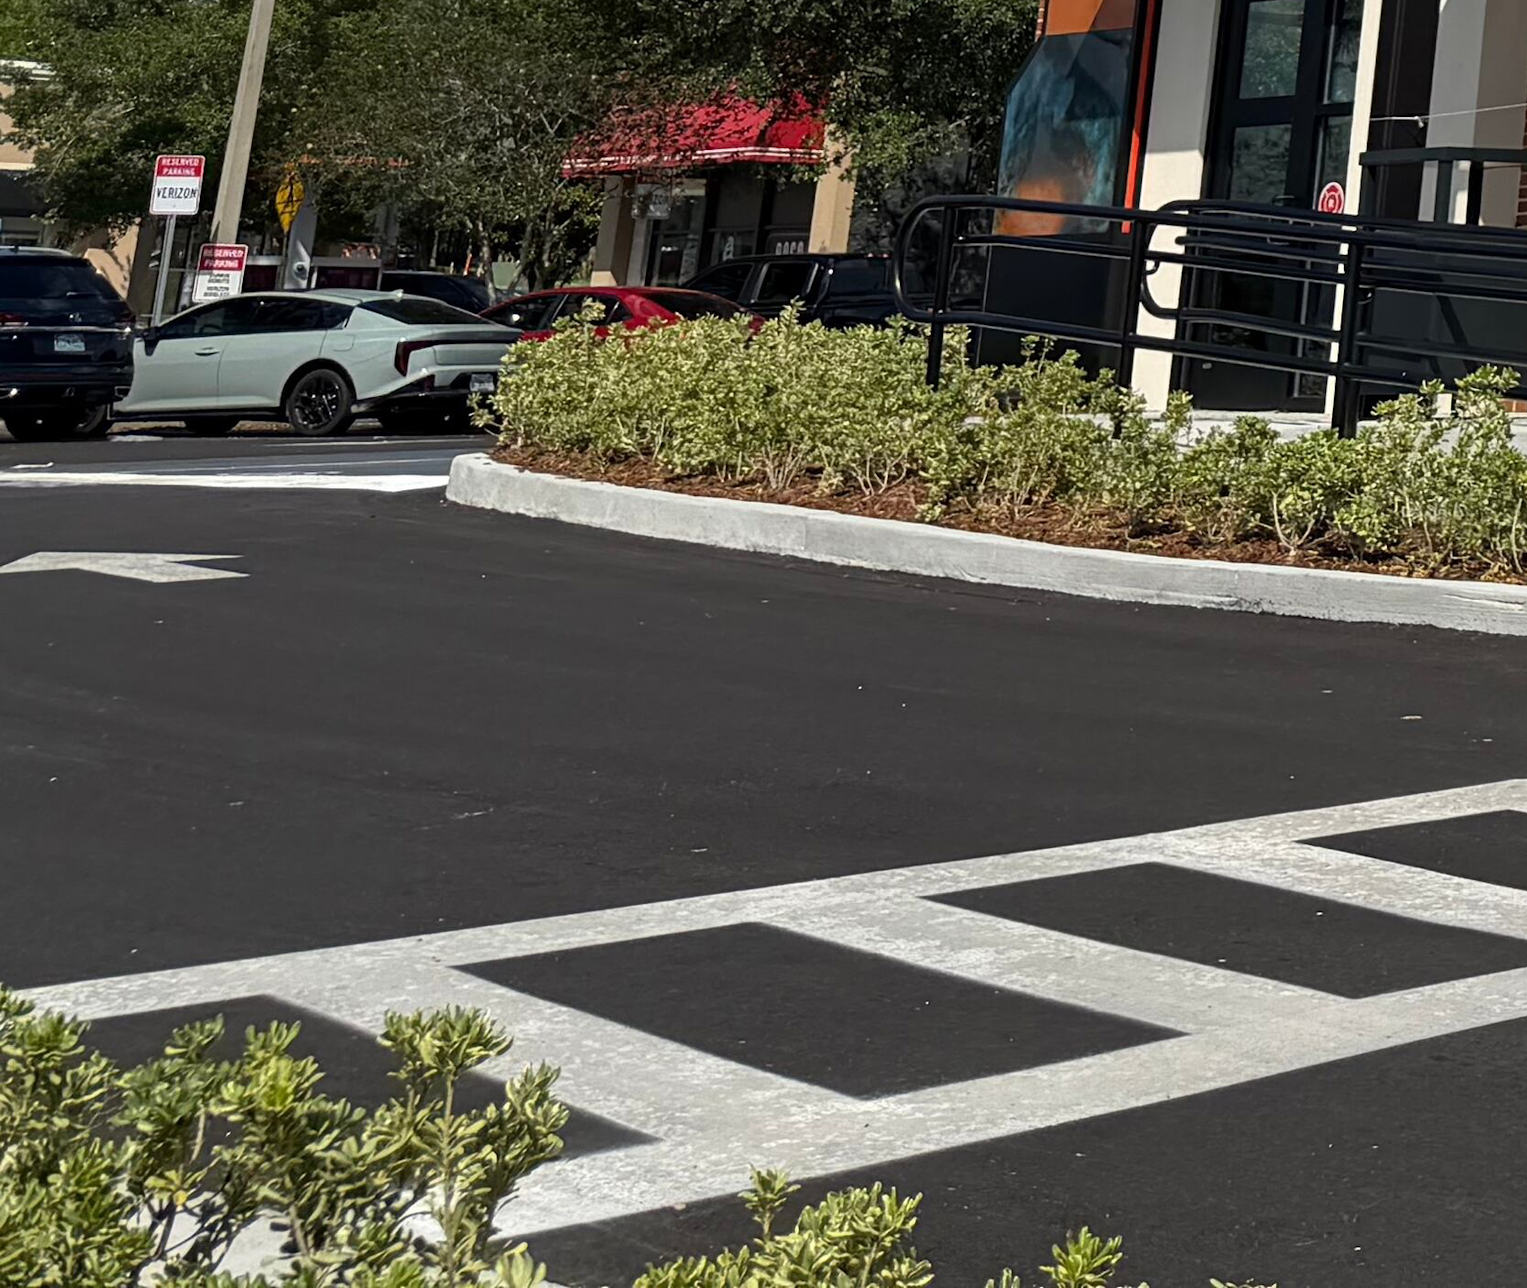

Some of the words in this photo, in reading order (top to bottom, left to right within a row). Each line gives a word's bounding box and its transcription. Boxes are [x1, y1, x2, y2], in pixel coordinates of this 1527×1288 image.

[161, 157, 200, 166] RESERVED
[162, 167, 196, 176] PARKING
[156, 187, 199, 199] VERIZON
